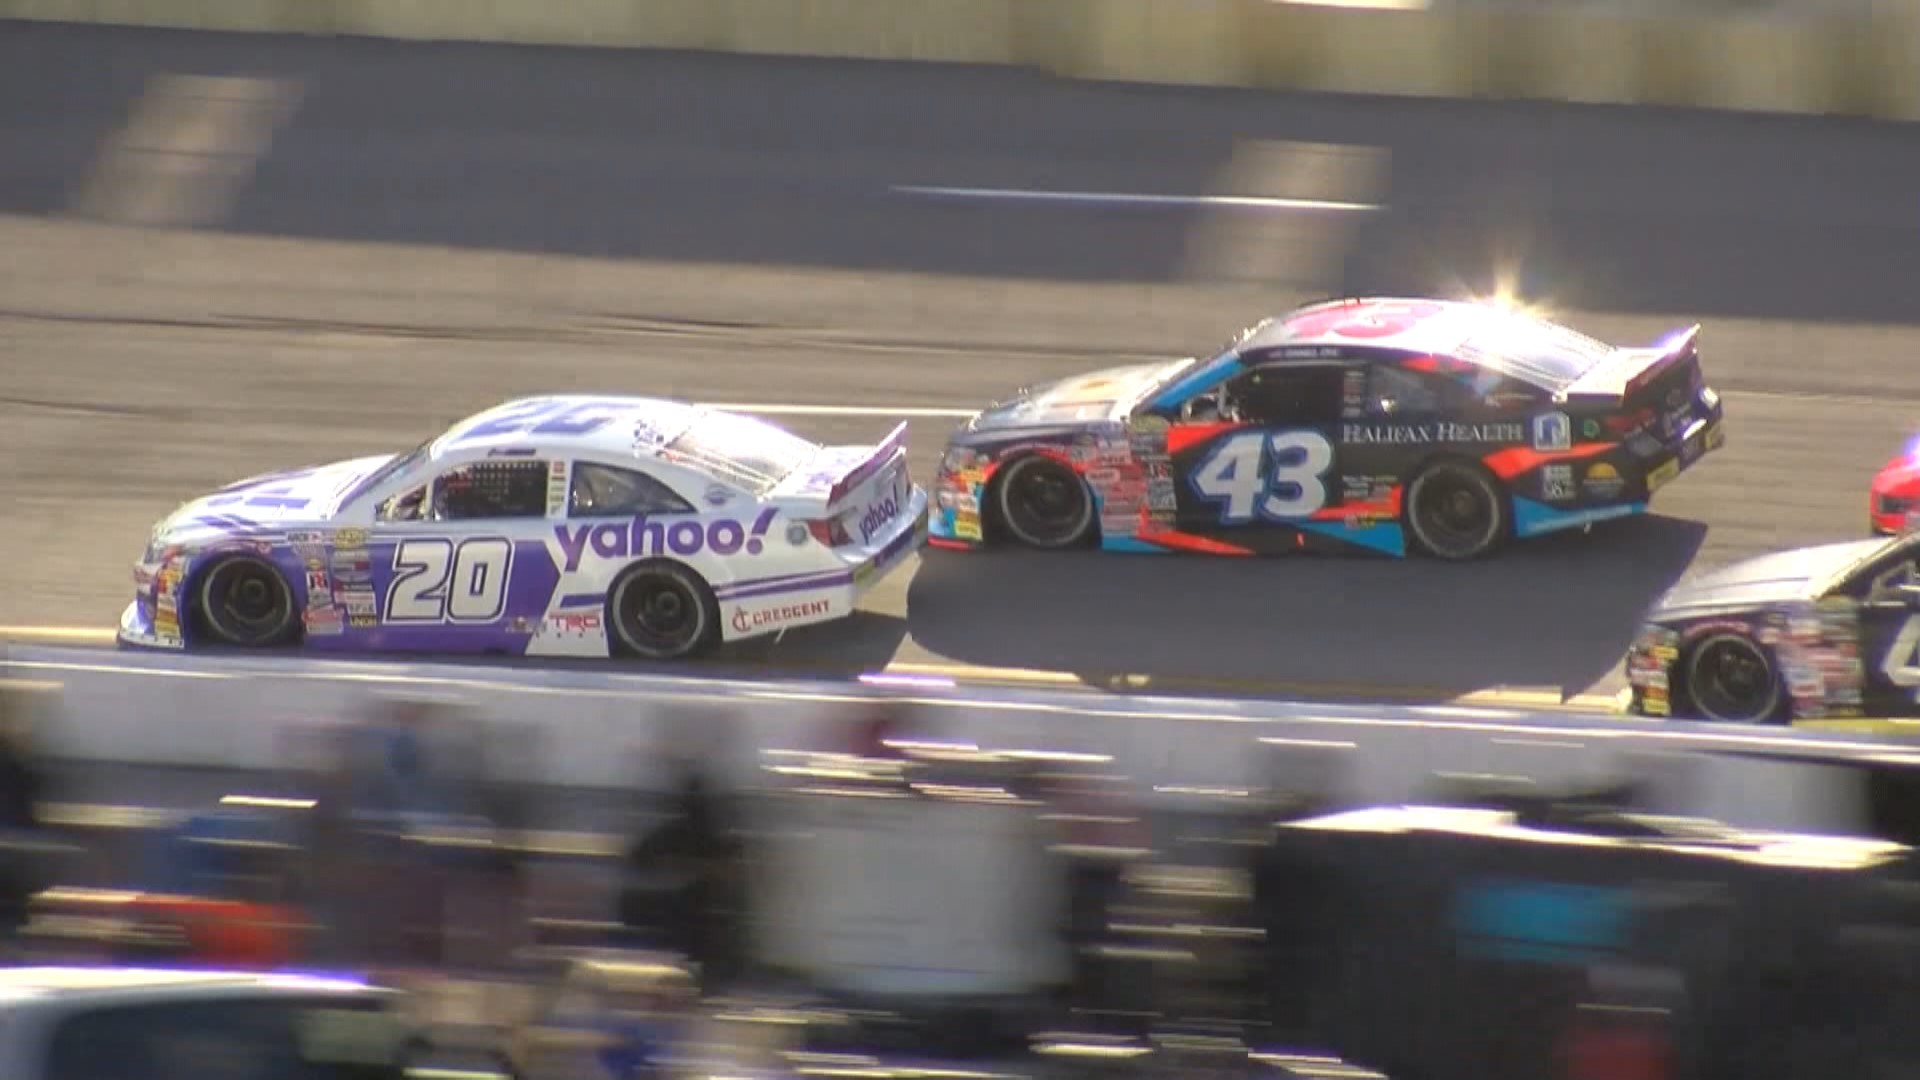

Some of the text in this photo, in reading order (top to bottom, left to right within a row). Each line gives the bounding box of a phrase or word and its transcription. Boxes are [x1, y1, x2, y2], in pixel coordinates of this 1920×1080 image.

[1343, 422, 1523, 443] HALIFAX HEALTH
[1190, 430, 1333, 519] 43
[554, 507, 779, 572] yahoo!
[383, 536, 515, 624] 20
